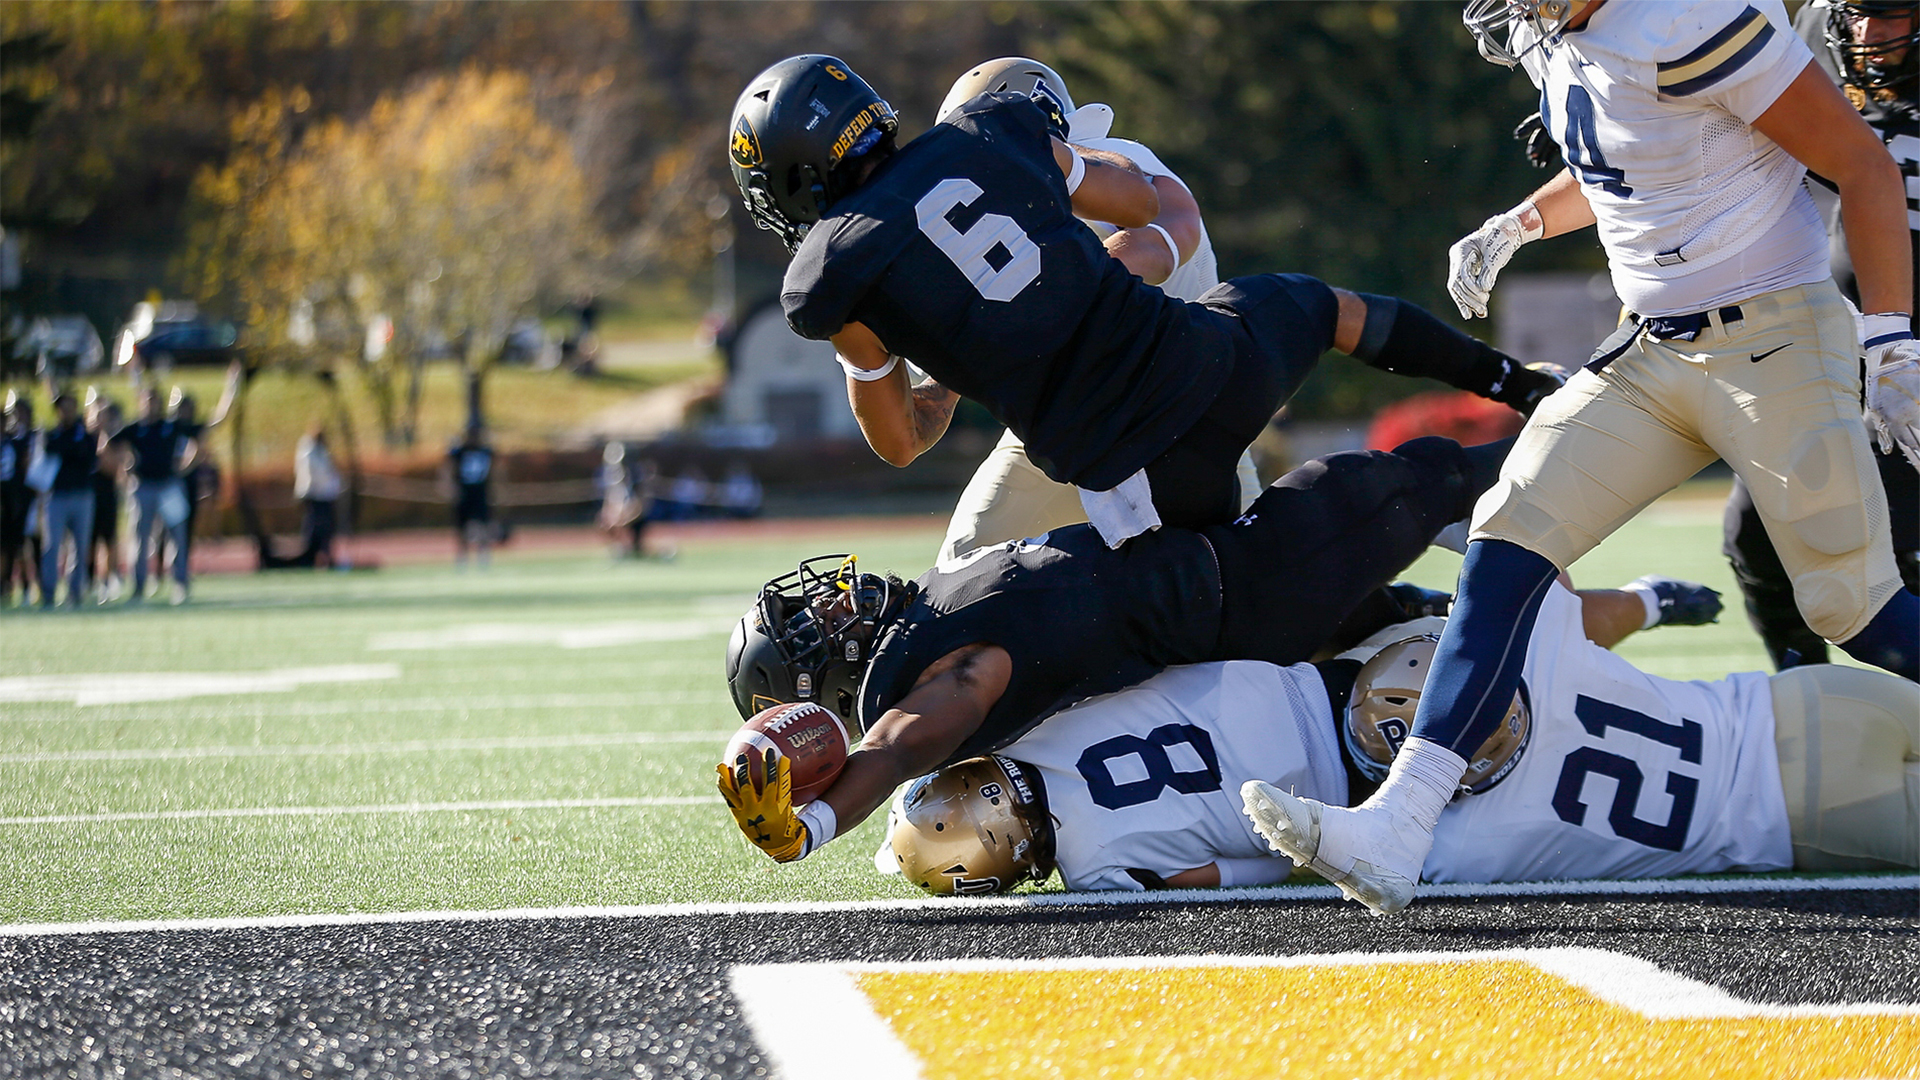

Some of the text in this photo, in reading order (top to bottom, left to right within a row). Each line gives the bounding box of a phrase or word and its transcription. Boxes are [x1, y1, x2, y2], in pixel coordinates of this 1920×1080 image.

[826, 65, 847, 81] 6
[833, 109, 873, 159] DEFEND
[868, 102, 890, 118] THE
[915, 178, 1041, 301] 6
[786, 723, 832, 748] Wilson
[979, 782, 1002, 799] 8
[996, 756, 1034, 805] THE ROP
[1075, 722, 1223, 813] 8
[1490, 750, 1522, 784] HOLD
[1551, 692, 1703, 852] 21
